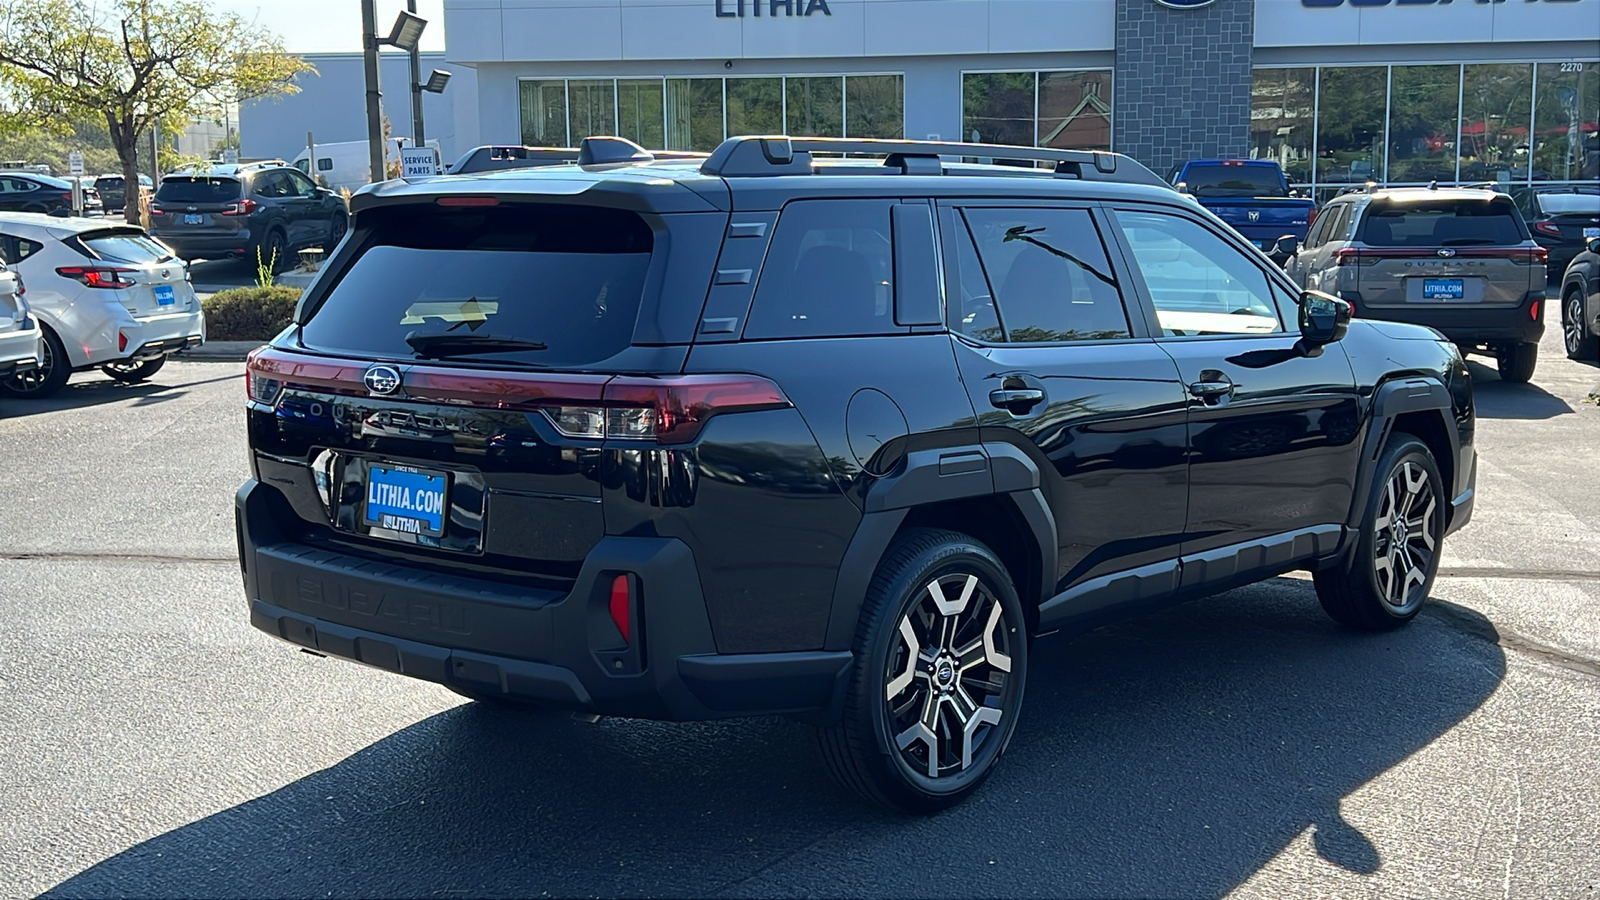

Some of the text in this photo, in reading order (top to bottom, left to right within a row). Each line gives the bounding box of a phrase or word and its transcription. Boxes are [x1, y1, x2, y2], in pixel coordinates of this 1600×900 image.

[1560, 62, 1583, 72] 2270
[404, 156, 432, 164] SERVICE
[310, 403, 475, 434] OUTBACK
[368, 481, 444, 515] LITHIA.COM
[392, 516, 420, 534] LITHIA
[296, 574, 472, 636] SUBARU
